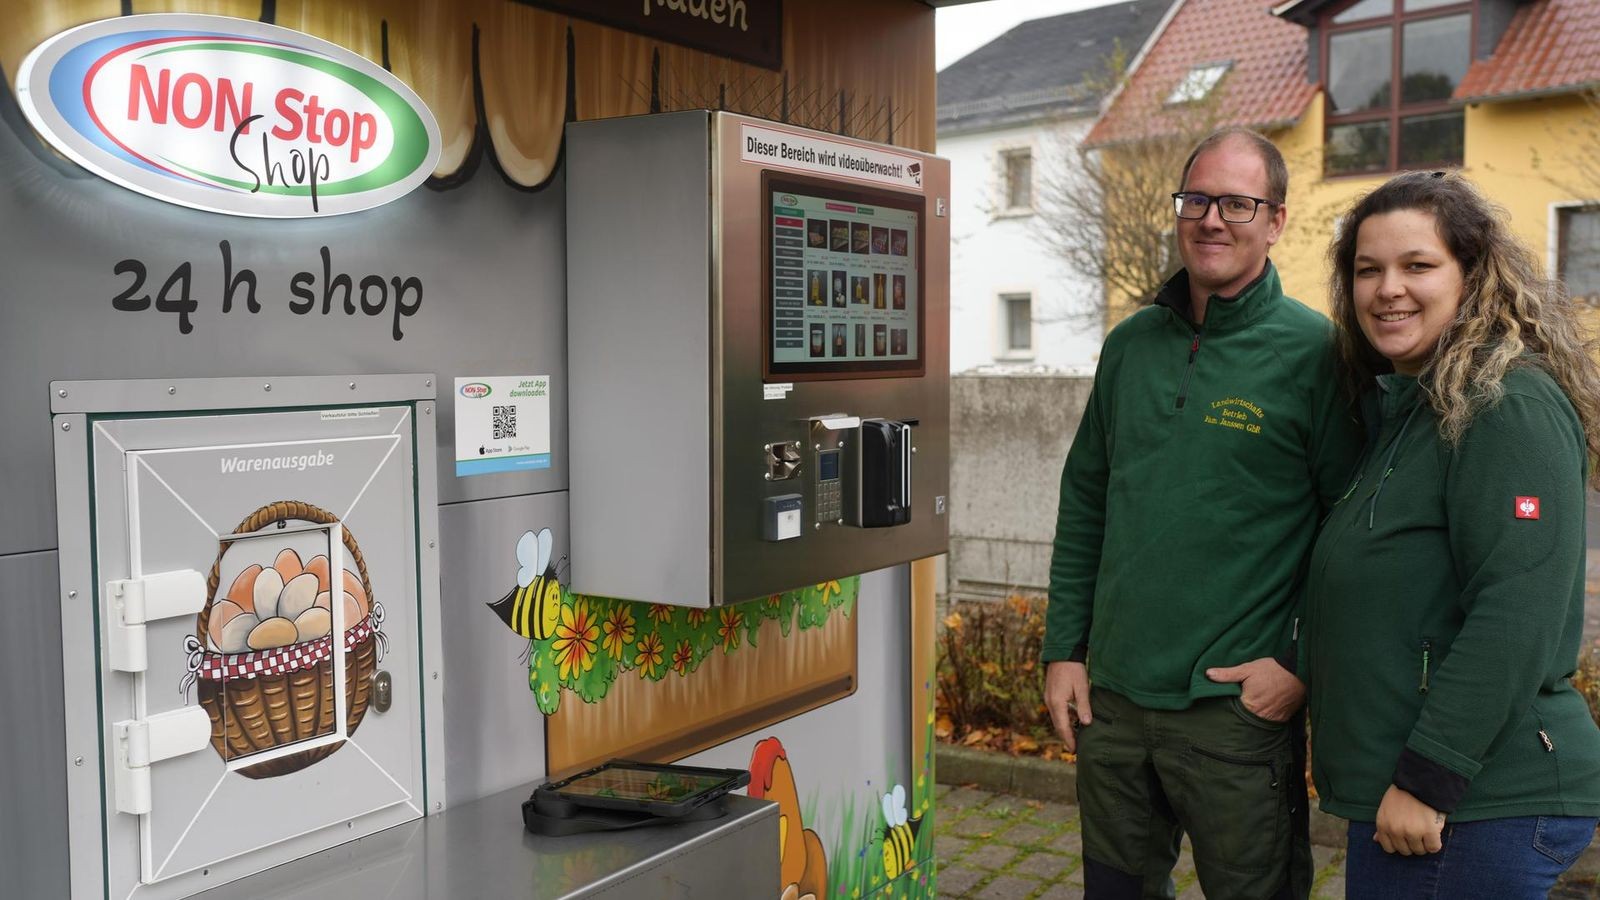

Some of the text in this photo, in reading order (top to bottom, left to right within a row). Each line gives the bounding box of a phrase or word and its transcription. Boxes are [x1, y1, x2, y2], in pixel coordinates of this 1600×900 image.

[127, 64, 377, 163] NON Stop
[229, 114, 329, 213] Shop
[747, 136, 903, 178] Dieser Bereich wird videoüberwacht!
[112, 240, 423, 341] 24 h shop
[518, 380, 547, 388] Jetzt App
[1220, 418, 1245, 430] Janssen
[1222, 409, 1248, 420] Betrieb
[220, 449, 334, 474] Warenausgabe
